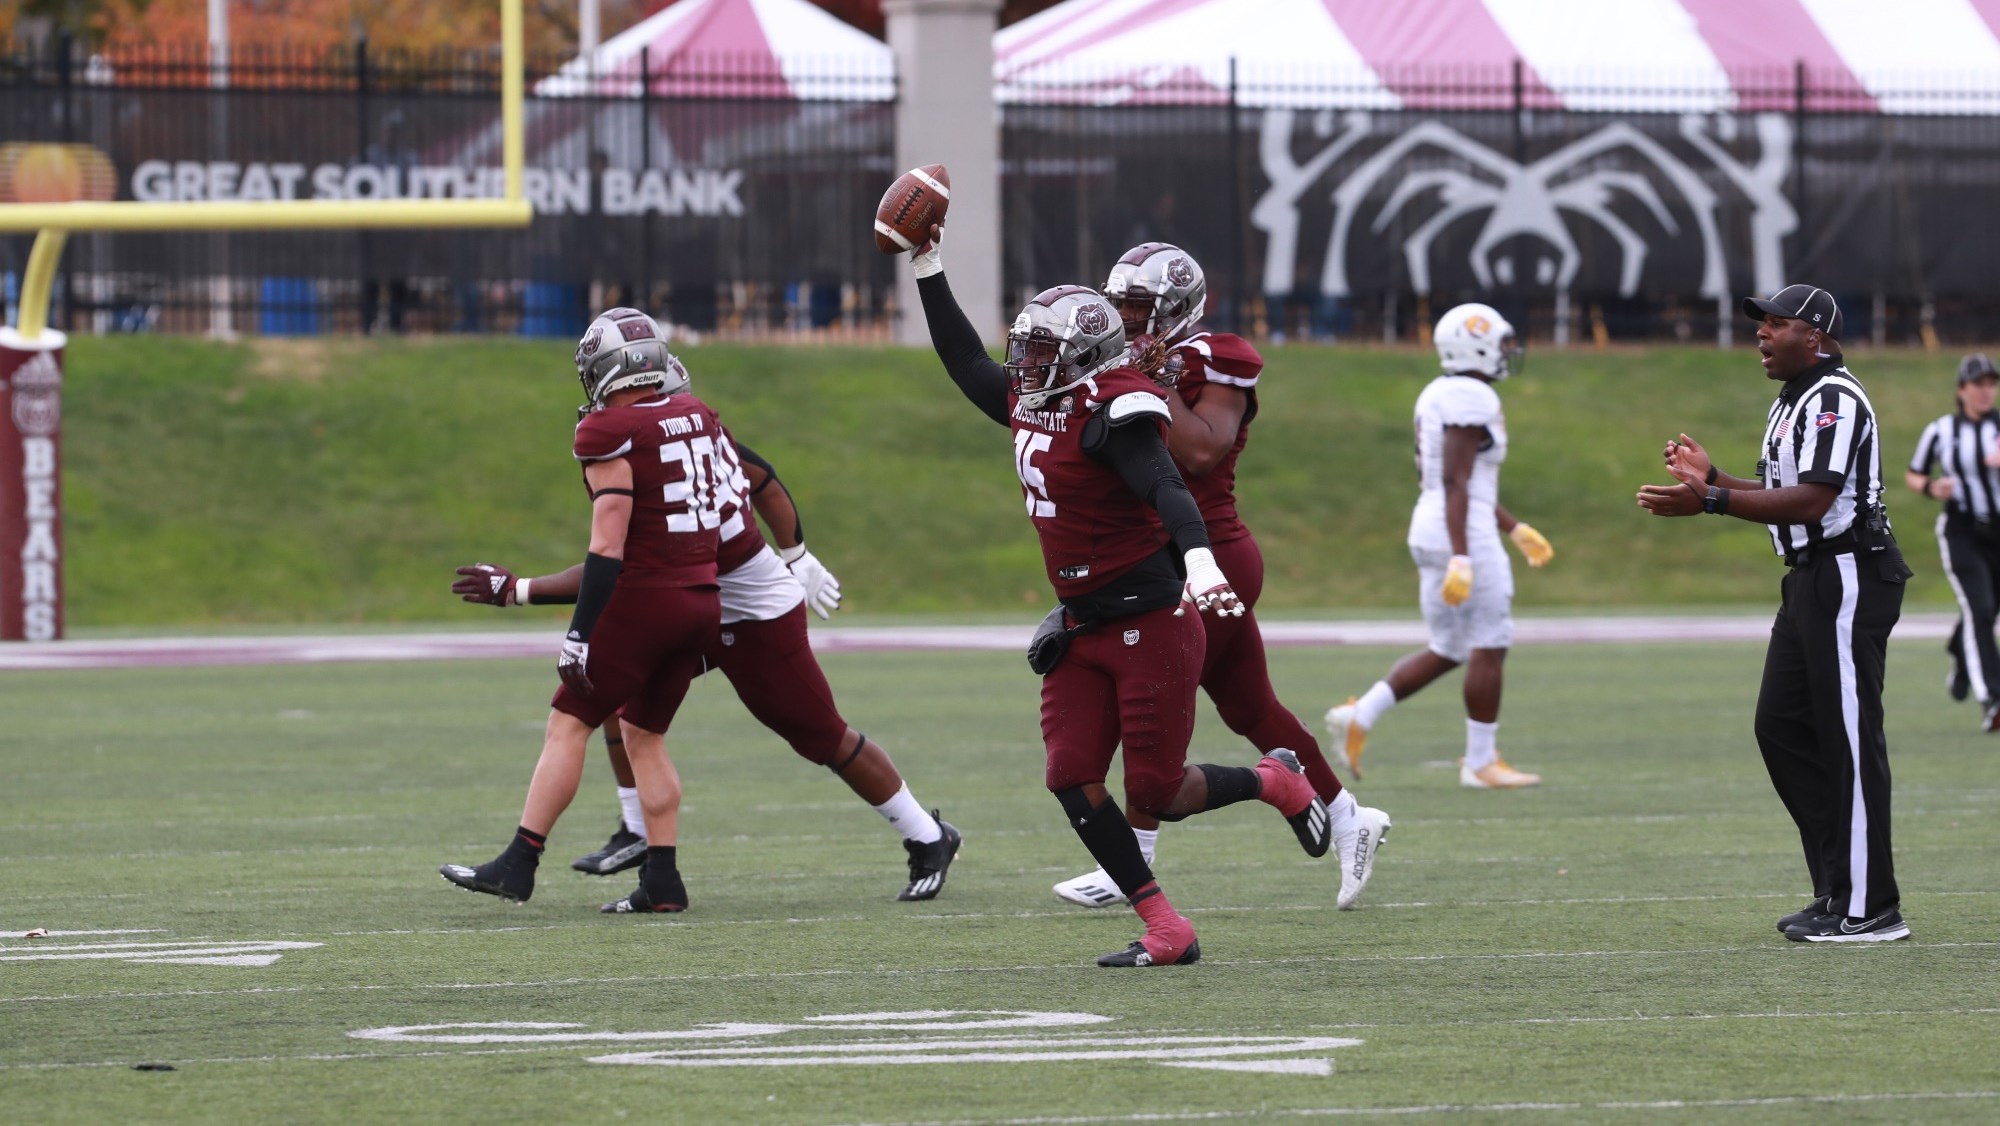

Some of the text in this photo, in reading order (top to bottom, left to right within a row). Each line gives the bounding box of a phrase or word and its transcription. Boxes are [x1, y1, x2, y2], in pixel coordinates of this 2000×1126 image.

[131, 159, 305, 202] GREAT
[602, 167, 744, 216] BANK
[633, 373, 660, 384] schutt
[658, 416, 692, 438] YOUNG
[1037, 411, 1067, 433] STATE
[659, 435, 720, 533] 30
[20, 435, 58, 641] BEARS
[1352, 828, 1370, 881] ADIZERO
